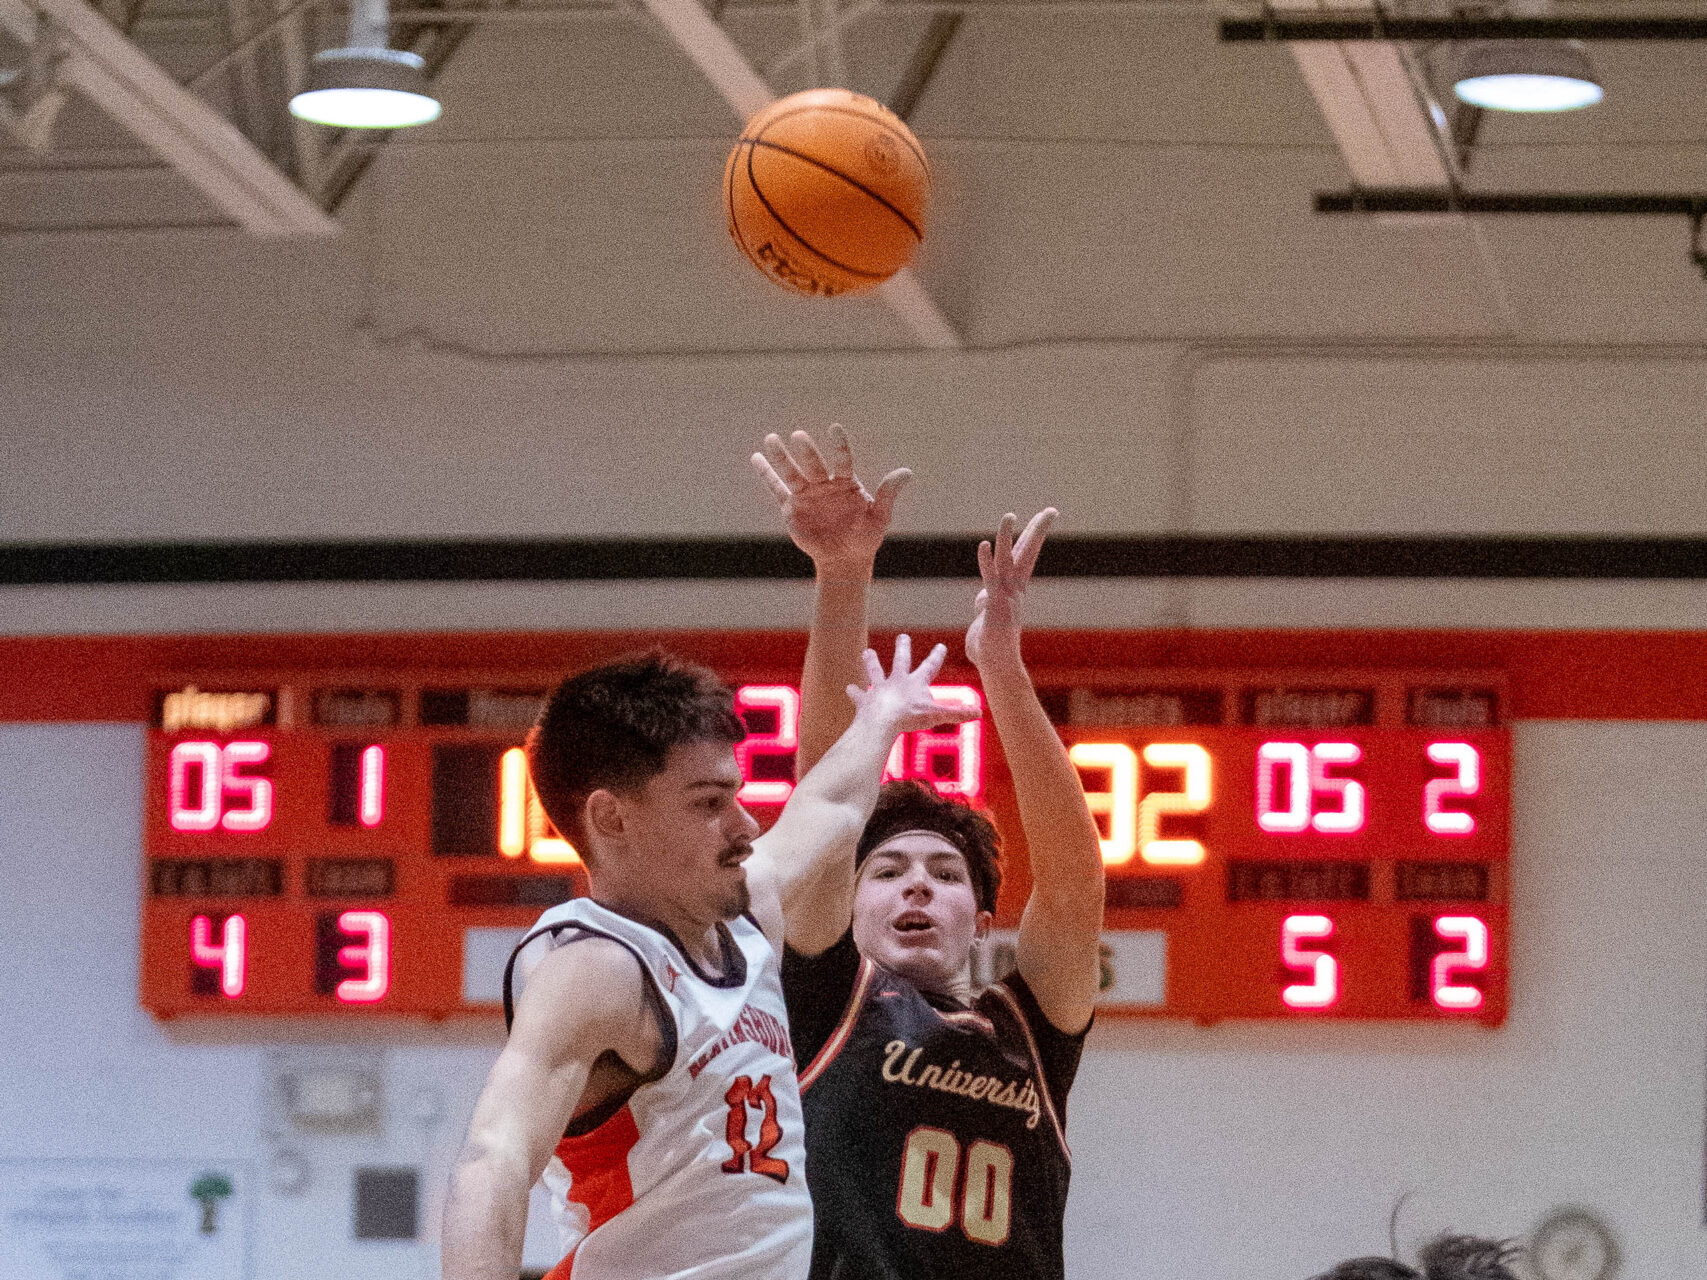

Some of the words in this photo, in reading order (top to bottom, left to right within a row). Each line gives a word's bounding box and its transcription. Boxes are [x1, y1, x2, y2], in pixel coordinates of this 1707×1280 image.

[169, 740, 273, 832] 05
[360, 744, 387, 828] 1
[1257, 740, 1368, 834] 05
[1424, 741, 1480, 835] 2
[190, 913, 248, 999] 4
[337, 910, 391, 1003] 3
[1282, 915, 1341, 1009] 5
[1432, 915, 1490, 1011] 2
[721, 1073, 790, 1185] 12
[881, 1039, 1041, 1130] University
[896, 1124, 1014, 1247] 00
